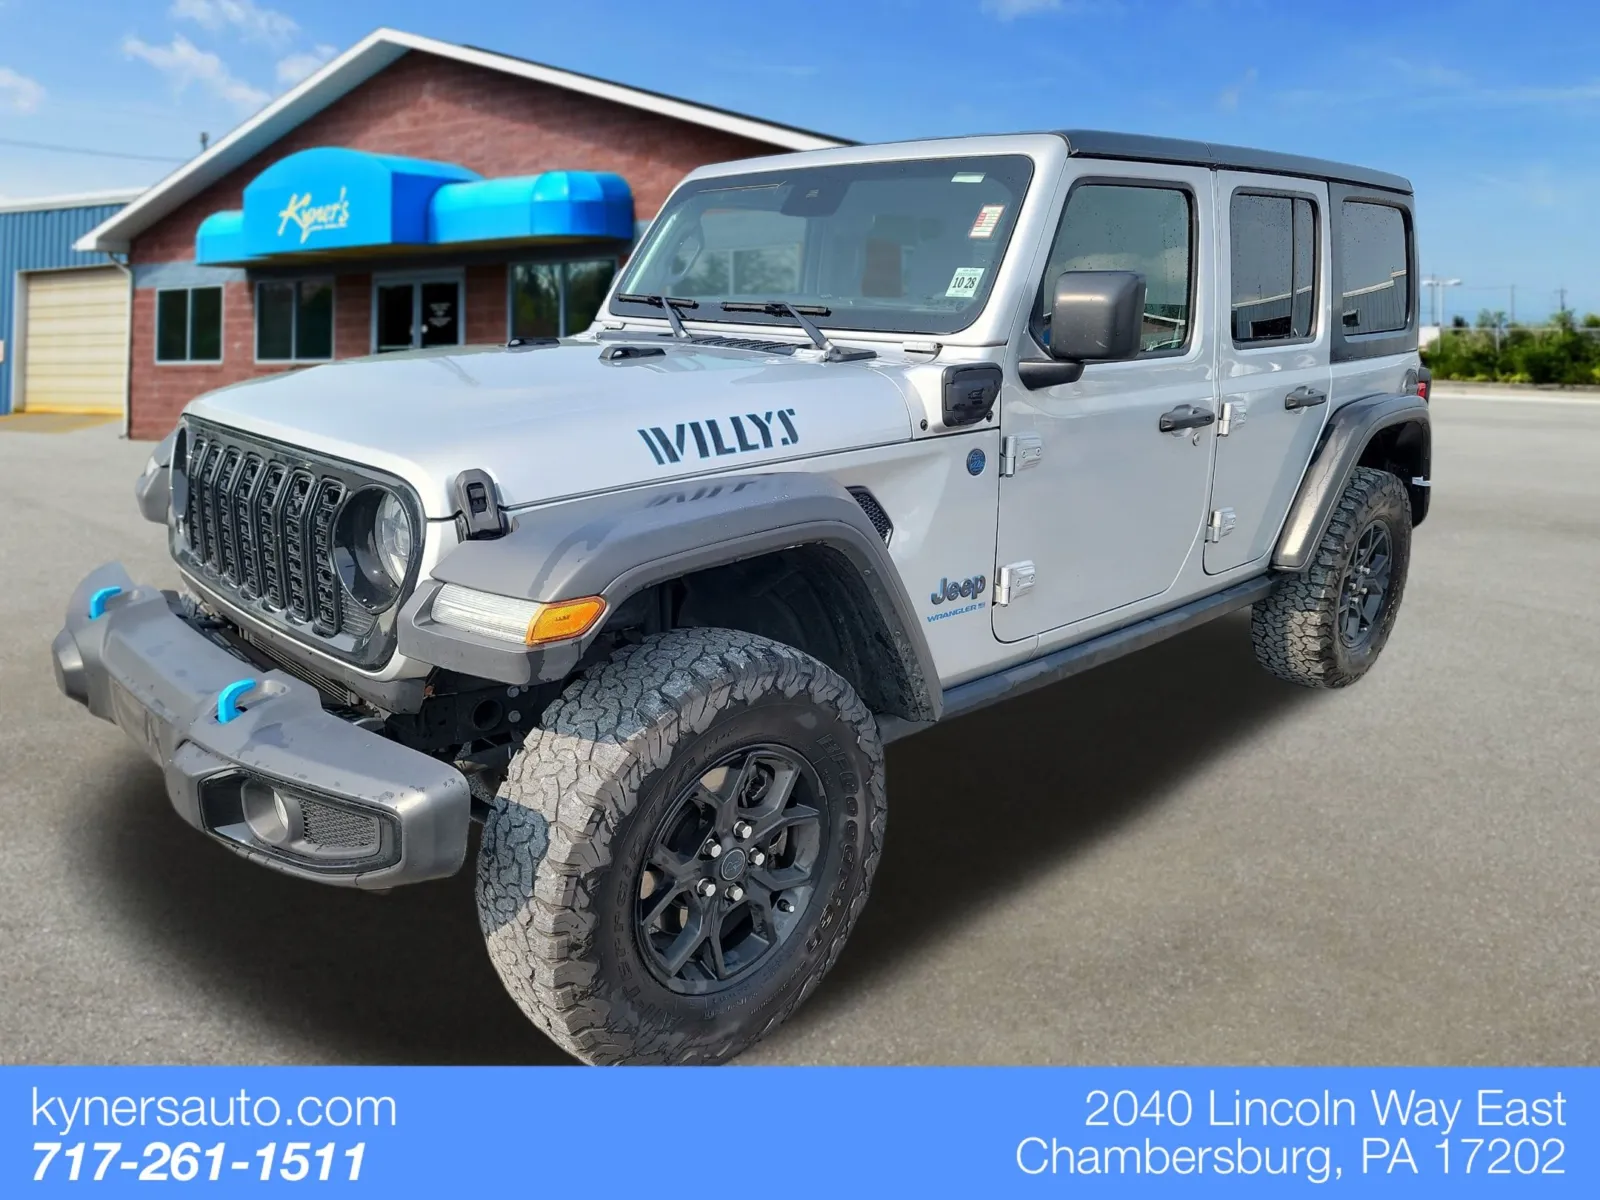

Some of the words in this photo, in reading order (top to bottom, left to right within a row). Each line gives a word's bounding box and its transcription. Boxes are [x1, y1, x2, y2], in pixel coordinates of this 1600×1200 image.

[952, 276, 965, 288] 10
[637, 408, 799, 465] WILLYS
[930, 574, 986, 605] Jeep
[927, 604, 977, 622] WRANGLER
